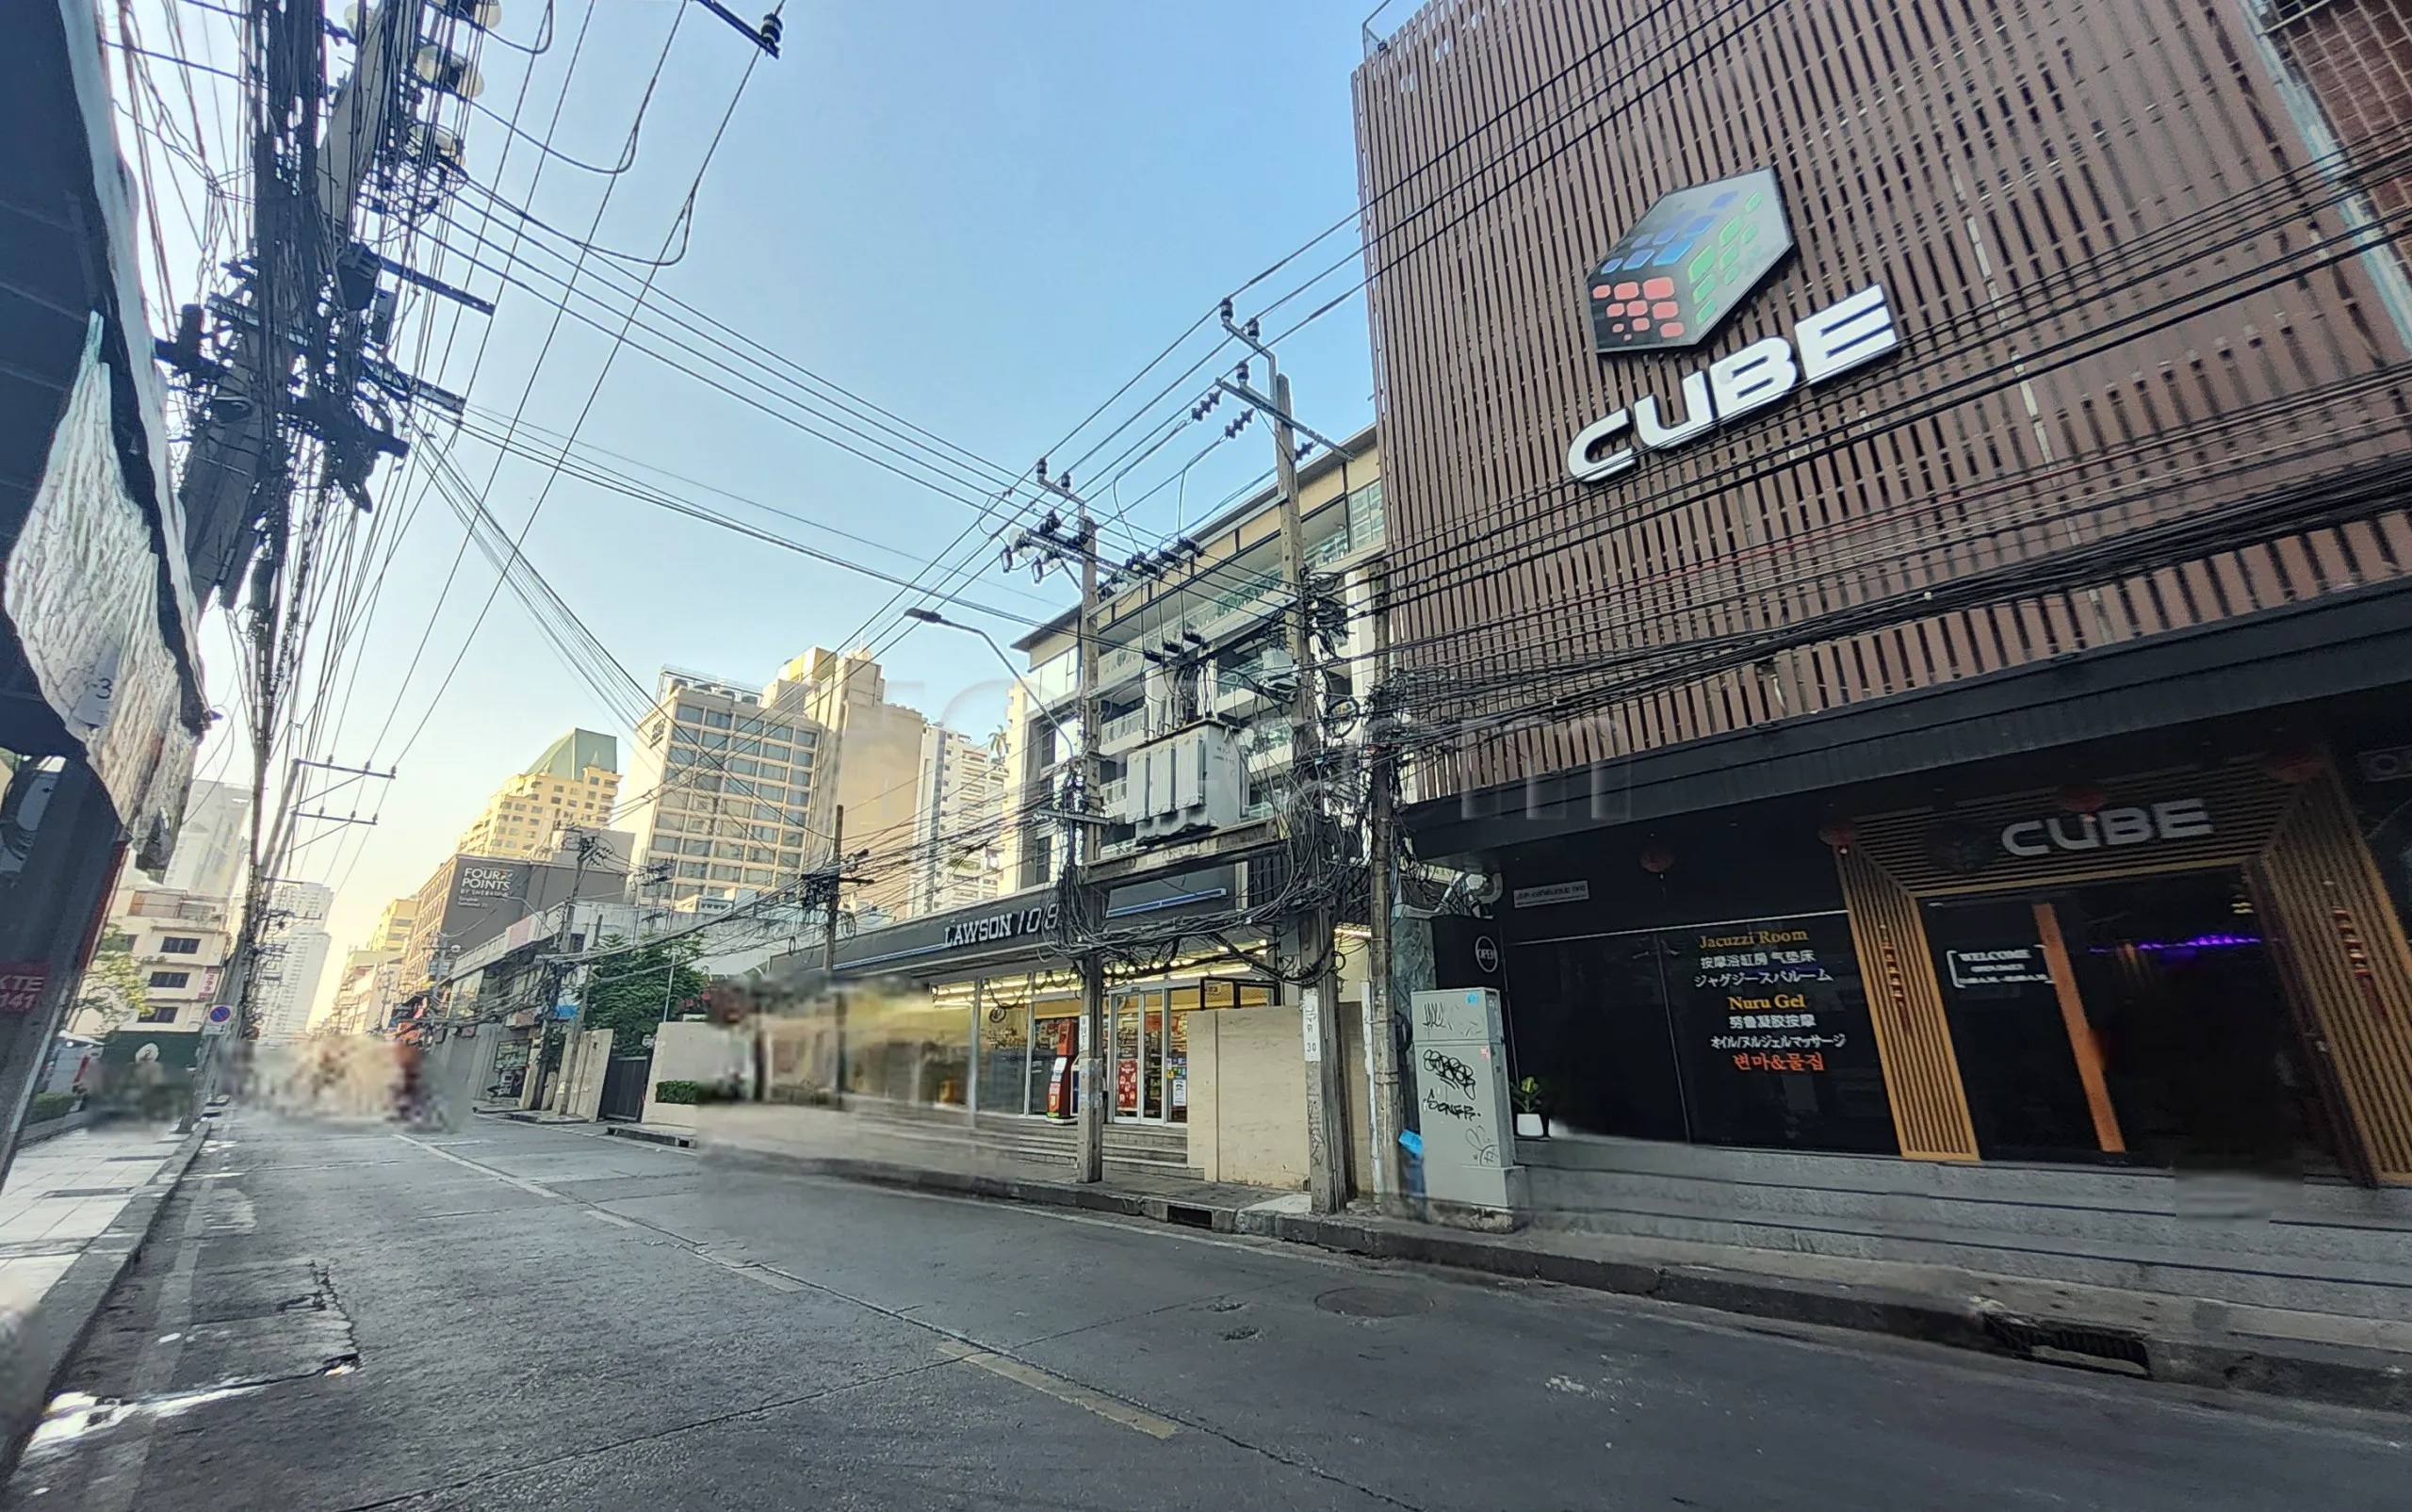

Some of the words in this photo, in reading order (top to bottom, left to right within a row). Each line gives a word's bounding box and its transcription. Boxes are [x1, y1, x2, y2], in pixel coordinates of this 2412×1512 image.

[1568, 284, 1898, 482] CUBE
[2002, 798, 2213, 856] CUBE
[464, 868, 500, 880] FOUR
[462, 878, 511, 891] POINTS
[944, 913, 1012, 948] LAWSON
[1018, 903, 1060, 935] 108
[1700, 932, 1755, 949] Jacuzzi
[1757, 930, 1809, 943] Room
[1727, 997, 1771, 1010] Nuru
[1774, 994, 1806, 1009] Gel
[1306, 1042, 1317, 1052] 30
